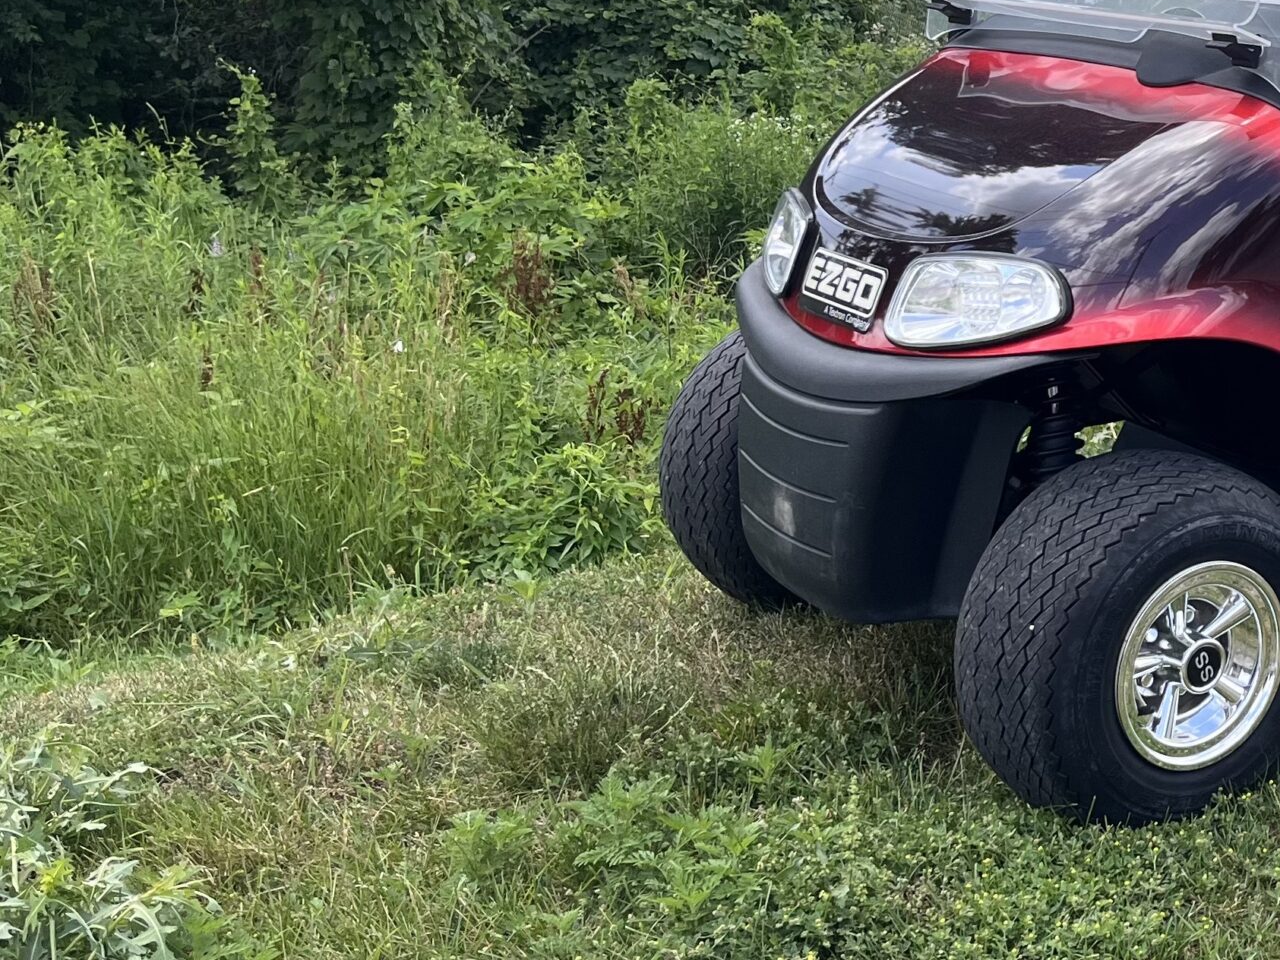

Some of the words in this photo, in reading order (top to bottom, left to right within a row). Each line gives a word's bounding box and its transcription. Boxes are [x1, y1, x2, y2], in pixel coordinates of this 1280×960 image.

[823, 305, 829, 314] A
[829, 306, 846, 321] Textron
[845, 313, 870, 332] Company
[1195, 651, 1214, 682] SS
